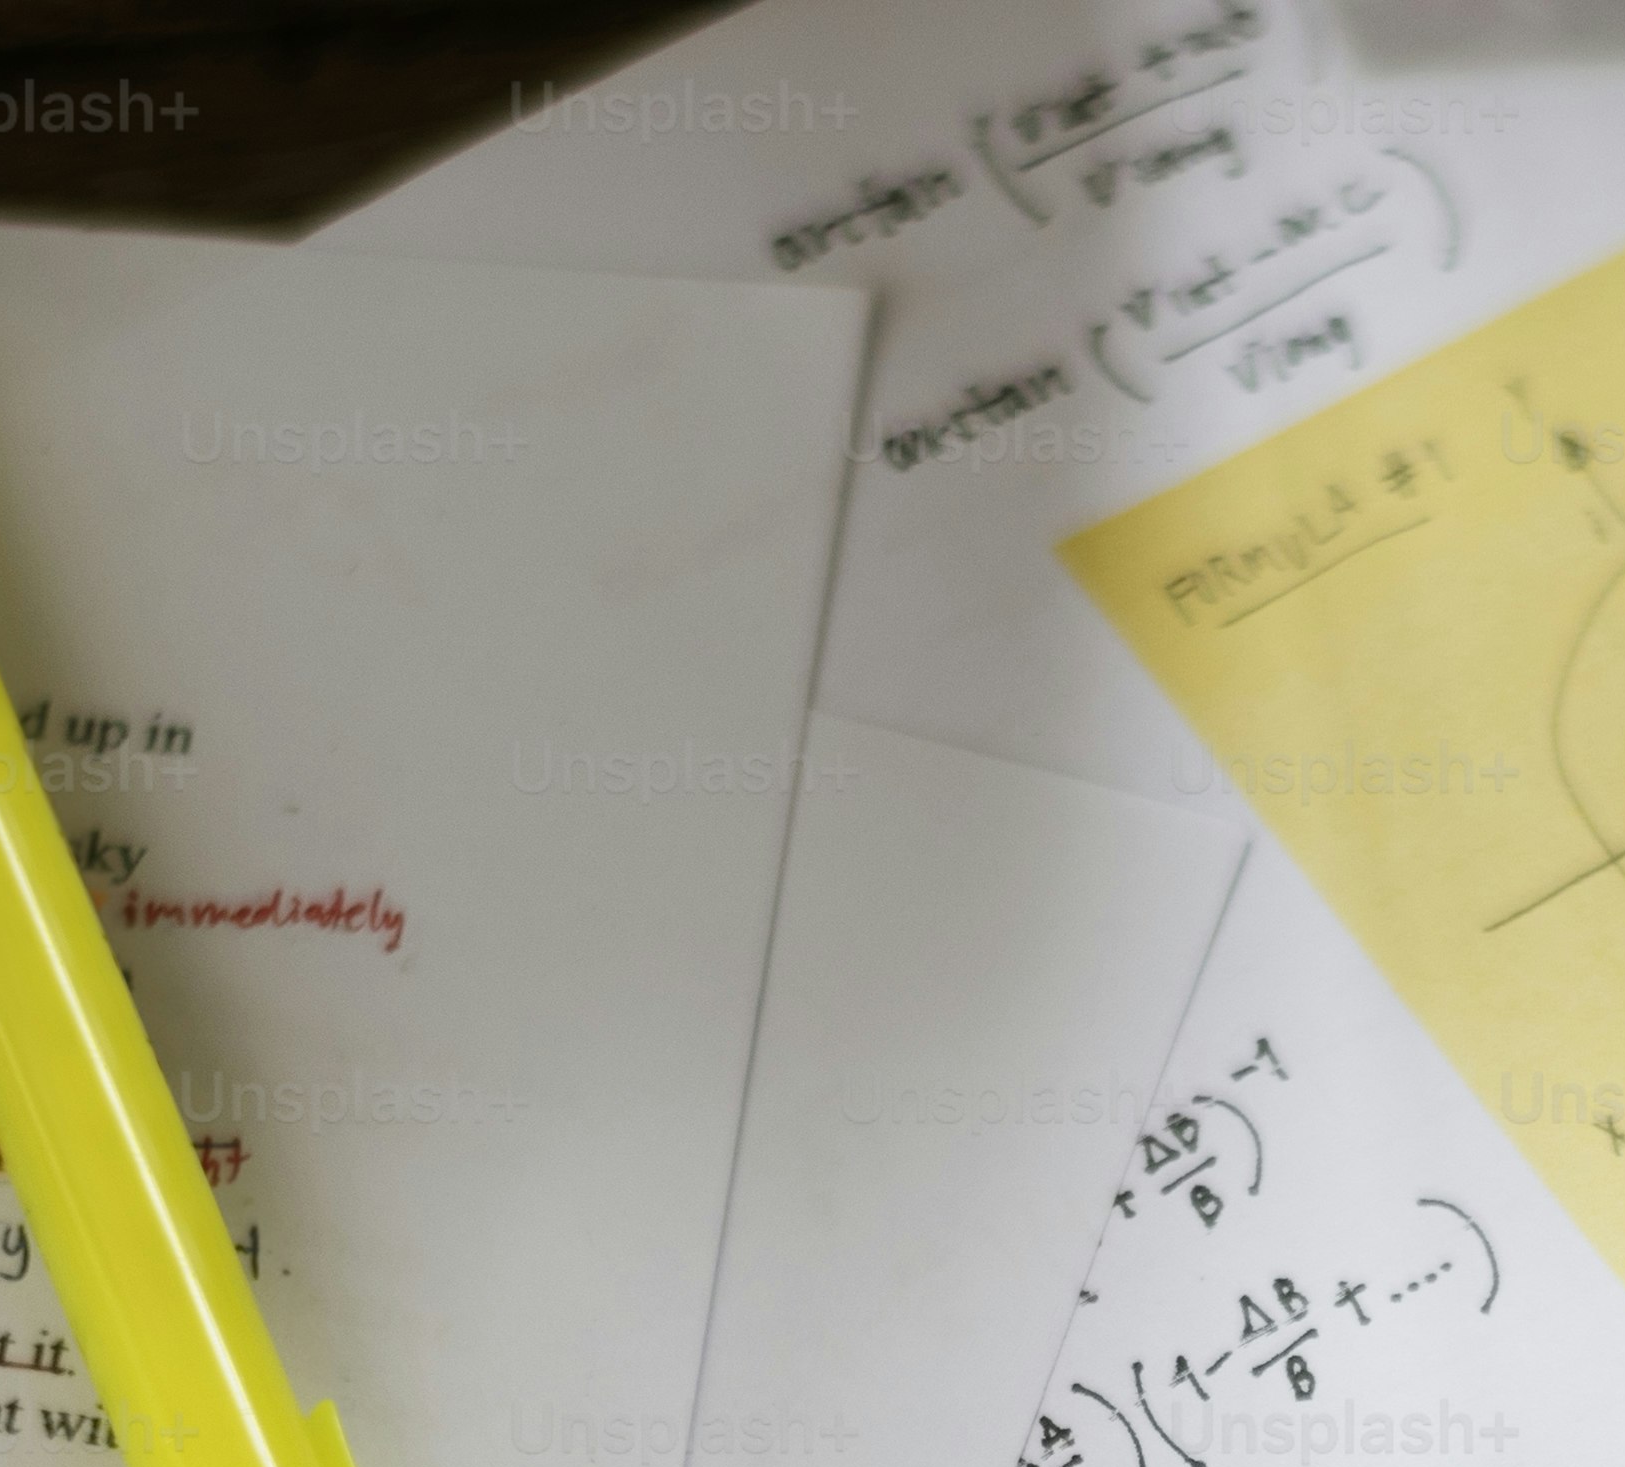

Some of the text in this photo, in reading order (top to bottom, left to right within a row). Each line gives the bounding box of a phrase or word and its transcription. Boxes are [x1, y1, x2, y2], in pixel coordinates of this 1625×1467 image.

[67, 714, 130, 756] up
[143, 709, 194, 754] in
[124, 887, 407, 952] immediately
